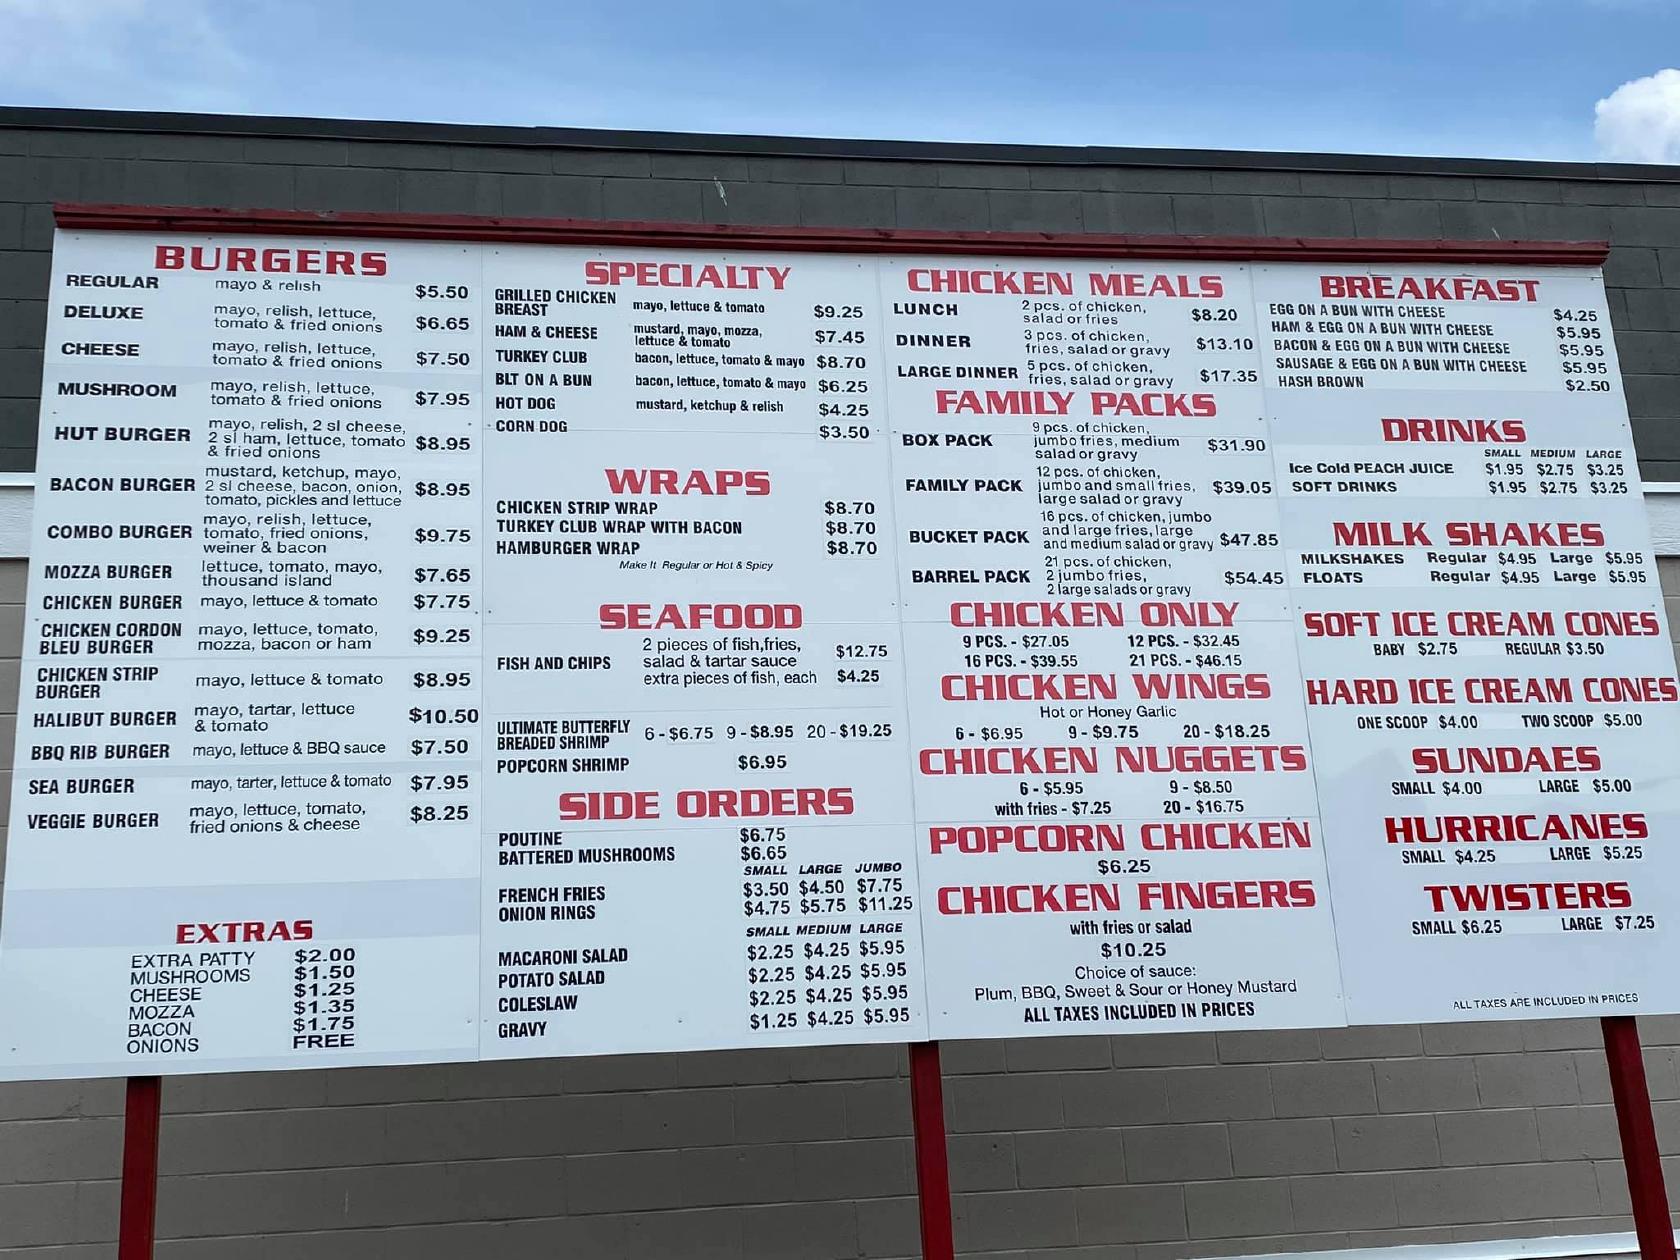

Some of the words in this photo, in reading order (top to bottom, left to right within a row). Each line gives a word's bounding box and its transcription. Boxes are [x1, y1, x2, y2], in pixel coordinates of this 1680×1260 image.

[155, 245, 387, 276] BURGERS
[66, 274, 159, 289] REGULAR
[585, 261, 791, 290] SPECIALTY
[907, 269, 1073, 295] CHICKEN
[1089, 273, 1223, 298] MEALS
[216, 280, 257, 292] mayo
[262, 279, 272, 290] &
[279, 280, 321, 292] relish
[415, 284, 468, 299] $5.50
[1320, 276, 1540, 302] BREAKFAST
[893, 303, 958, 316] LUNCH
[1022, 300, 1030, 310] 2
[1034, 303, 1065, 313] pcs.
[1069, 300, 1082, 312] of
[1086, 301, 1146, 313] chicken,
[1269, 303, 1295, 315] EGG
[1298, 304, 1316, 316] ON
[1320, 304, 1328, 316] A
[1331, 304, 1358, 317] BUN
[1361, 305, 1394, 317] WITH
[1398, 306, 1445, 318] CHEESE
[1191, 308, 1237, 322] $8.20
[1553, 308, 1598, 322] $4.25
[214, 317, 268, 329] tomato
[274, 318, 285, 330] &
[290, 319, 326, 331] fried
[332, 321, 382, 333] onions
[496, 396, 524, 409] HOT
[527, 397, 555, 410] DOG
[636, 399, 687, 412] mustard,
[690, 399, 737, 414] ketchup
[740, 400, 749, 412] &
[752, 400, 783, 412] relish
[819, 402, 869, 417] $4.25
[936, 390, 1075, 415] FAMILY
[1090, 392, 1216, 417] PACKS
[54, 426, 99, 441] HUT
[104, 427, 190, 442] BURGER
[1381, 418, 1526, 443] DRINKS
[415, 435, 470, 451] $8.95
[902, 433, 940, 446] BOX
[945, 434, 993, 447] PACK
[1034, 434, 1077, 448] jumbo
[1080, 435, 1117, 448] fries,
[1121, 435, 1180, 446] medium
[1208, 438, 1266, 453] $31.90
[1484, 449, 1522, 457] SMALL
[1530, 449, 1576, 458] MEDIUM
[1586, 450, 1622, 459] LARGE
[1289, 463, 1313, 473] Ice
[1316, 463, 1350, 473] Cold
[1354, 463, 1405, 474] PEACH
[1409, 463, 1454, 474] JUICE
[1485, 462, 1523, 476] $1.95
[1536, 463, 1574, 477] $2.75
[1587, 463, 1624, 477] $3.25
[604, 469, 770, 496] WRAPS
[1332, 522, 1433, 546] MILK
[1445, 522, 1605, 547] SHAKES
[619, 560, 647, 569] Make
[650, 561, 657, 569] It
[662, 560, 701, 571] Regular
[715, 561, 733, 569] Hot
[736, 561, 742, 569] &
[746, 561, 773, 572] Spicy
[1301, 553, 1404, 564] MILKSHAKES
[44, 565, 101, 579] MOZZA
[107, 565, 172, 579] BURGER
[600, 604, 802, 629] SEAFOOD
[950, 602, 1124, 627] CHICKEN
[1140, 602, 1239, 627] ONLY
[1304, 612, 1381, 637] SOFT
[1391, 612, 1439, 636] ICE
[1447, 612, 1555, 636] CREAM
[1564, 612, 1659, 636] CONES
[643, 637, 652, 651] 2
[657, 637, 708, 654] pieces
[713, 637, 728, 651] of
[1127, 634, 1144, 647] 12
[1148, 634, 1179, 648] PCS.
[1193, 634, 1240, 648] $32.45
[1373, 643, 1405, 656] BABY
[1418, 641, 1458, 656] $2.75
[836, 644, 888, 659] $12.75
[497, 657, 530, 670] FISH
[534, 657, 564, 670] AND
[568, 656, 611, 670] CHIPS
[941, 674, 1117, 701] CHICKEN
[1132, 673, 1271, 699] WINGS
[1306, 679, 1399, 705] HARD
[1408, 679, 1456, 704] ICE
[1464, 678, 1573, 704] CREAM
[1583, 678, 1679, 703] CONES
[194, 706, 243, 719] mayo,
[248, 704, 295, 717] tartar,
[302, 702, 355, 715] lettuce
[409, 706, 479, 724] $10.50
[1040, 706, 1066, 718] Hot
[1069, 709, 1084, 718] or
[1087, 705, 1132, 720] Honey
[1136, 705, 1177, 717] Garlic
[33, 712, 105, 728] HALIBUT
[110, 711, 176, 726] BURGER
[1357, 716, 1383, 729] ONE
[1385, 715, 1428, 729] SCOOP
[919, 747, 1098, 775] CHICKEN
[1115, 746, 1307, 773] NUGGETS
[1412, 746, 1601, 774] SUNDAES
[559, 791, 660, 820] SIDE
[677, 787, 854, 818] ORDERS
[27, 814, 86, 829] VEGGIE
[92, 813, 159, 828] BURGER
[410, 805, 468, 823] $8.25
[1384, 813, 1648, 843] HURRICANES
[929, 824, 1125, 854] POPCORN
[1140, 822, 1311, 851] CHICKEN
[743, 865, 788, 876] SMALL
[798, 864, 843, 875] LARGE
[855, 862, 902, 873] JUMBO
[1098, 859, 1151, 875] $6.25
[938, 883, 1120, 915] CHICKEN
[1137, 880, 1316, 911] FINGERS
[1423, 881, 1632, 912] TWISTERS
[499, 906, 546, 922] ONION
[550, 905, 596, 920] RINGS
[744, 900, 790, 916] $4.75
[800, 898, 846, 915] $5.75
[858, 896, 913, 913] $11.25
[1561, 916, 1603, 931] LARGE
[1614, 915, 1655, 931] $7.25
[176, 920, 313, 944] EXTRAS
[131, 953, 193, 969] EXTRA
[200, 951, 255, 966] PATTY
[294, 948, 355, 965] $2.00
[1075, 965, 1126, 980] Choice
[1130, 965, 1144, 978] of
[1149, 967, 1196, 978] sauce:
[498, 995, 578, 1013] COLESLAW
[1454, 1000, 1472, 1009] ALL
[1473, 999, 1507, 1008] TAXES
[1510, 998, 1531, 1007] ARE
[1533, 996, 1585, 1006] INCLUDED
[1588, 995, 1599, 1004] IN
[1601, 993, 1638, 1003] PRICES
[128, 1021, 191, 1038] BACON
[293, 1016, 354, 1033] $1.75
